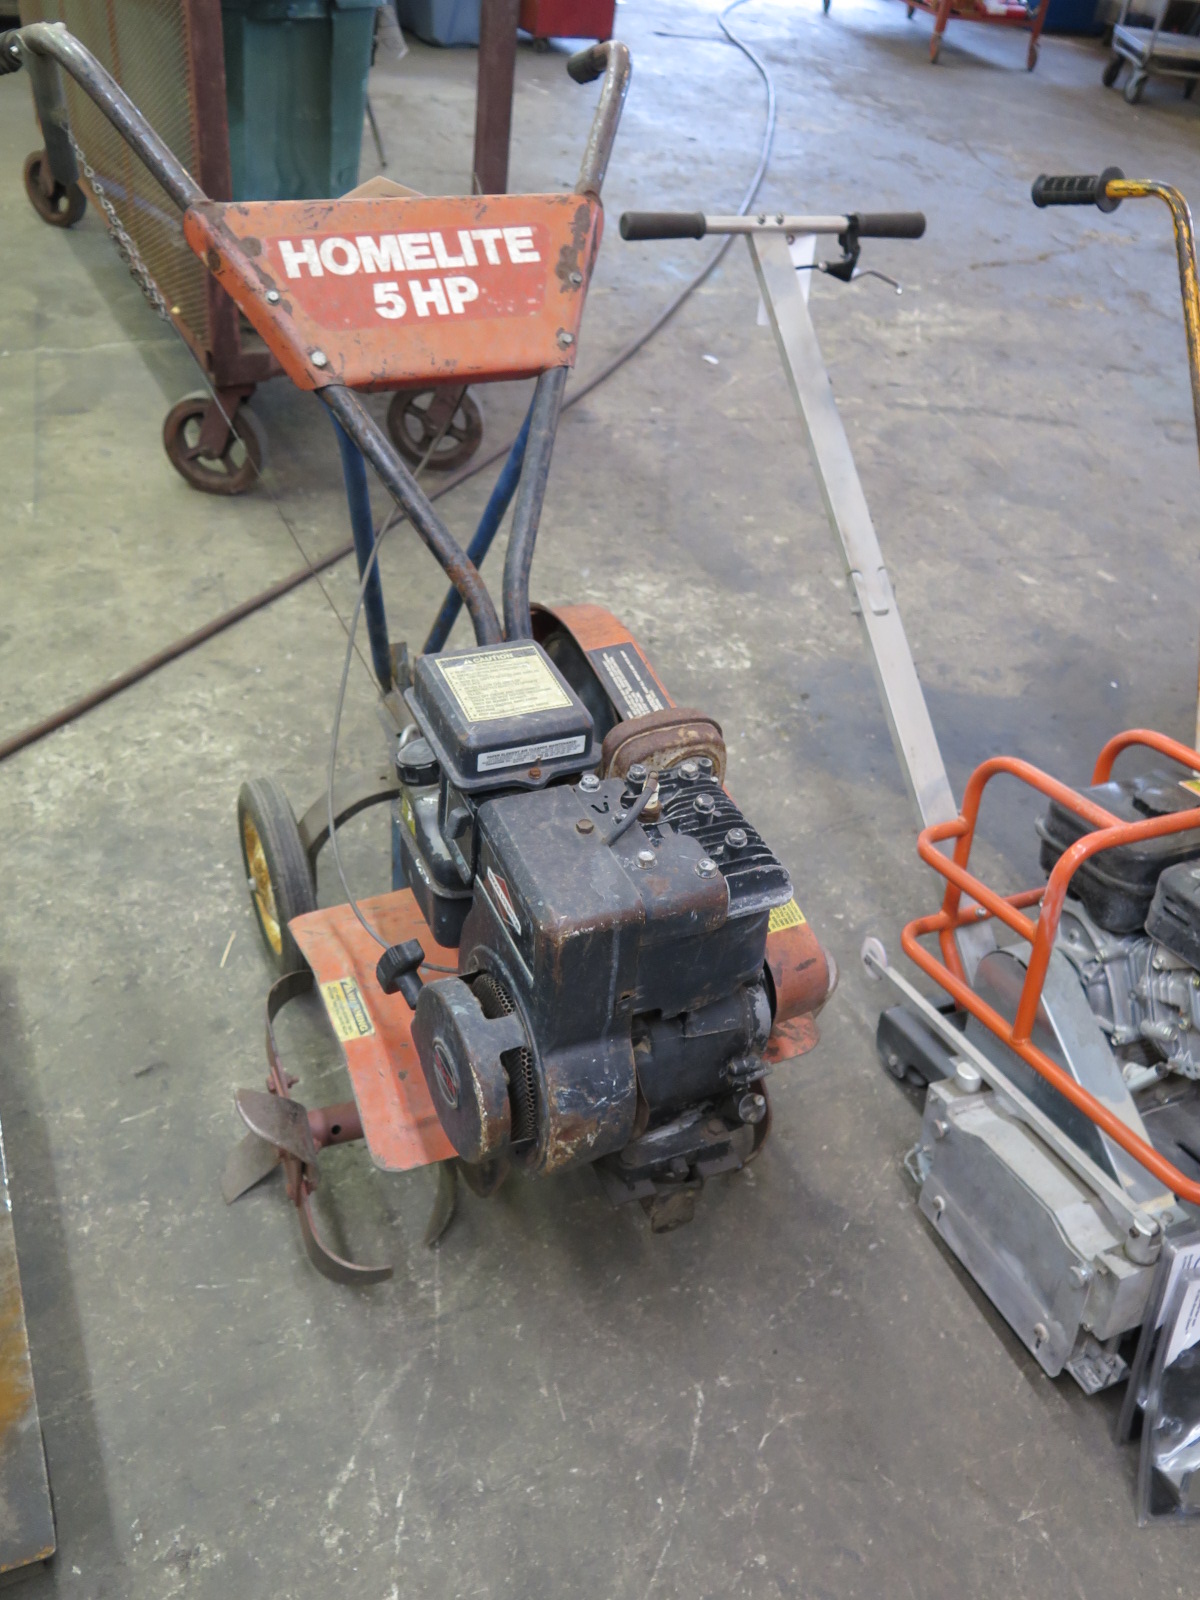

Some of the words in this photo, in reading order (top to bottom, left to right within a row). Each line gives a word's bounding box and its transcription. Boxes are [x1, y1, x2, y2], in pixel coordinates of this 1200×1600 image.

[278, 227, 541, 278] HOMELITE
[373, 281, 407, 319] 5
[408, 276, 479, 318] HP
[472, 653, 514, 664] CAUTION
